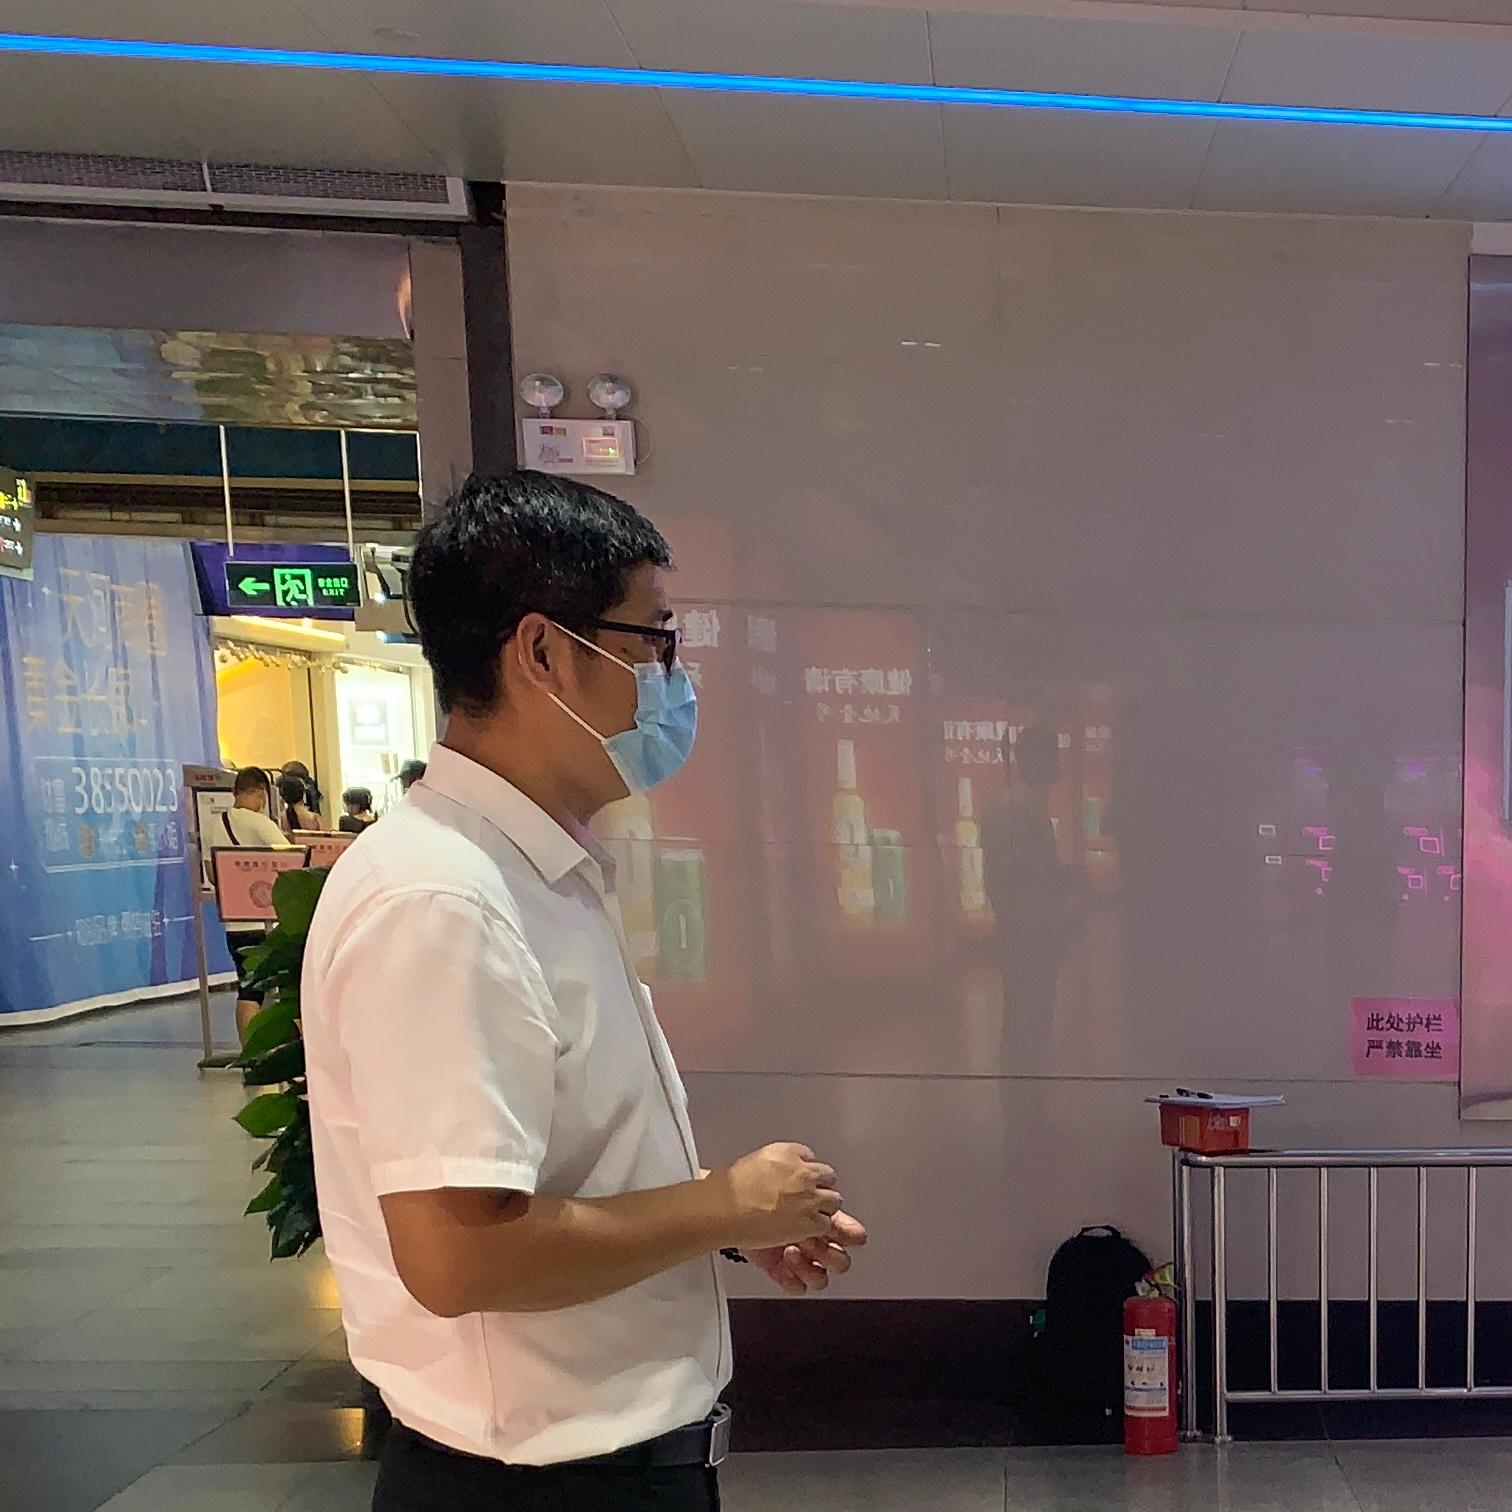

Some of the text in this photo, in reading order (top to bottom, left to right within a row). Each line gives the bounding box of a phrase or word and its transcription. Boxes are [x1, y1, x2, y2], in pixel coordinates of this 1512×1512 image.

[322, 588, 346, 597] EXIT
[1366, 1013, 1443, 1033] 此处护栏
[1366, 1039, 1443, 1059] 严禁靠坐
